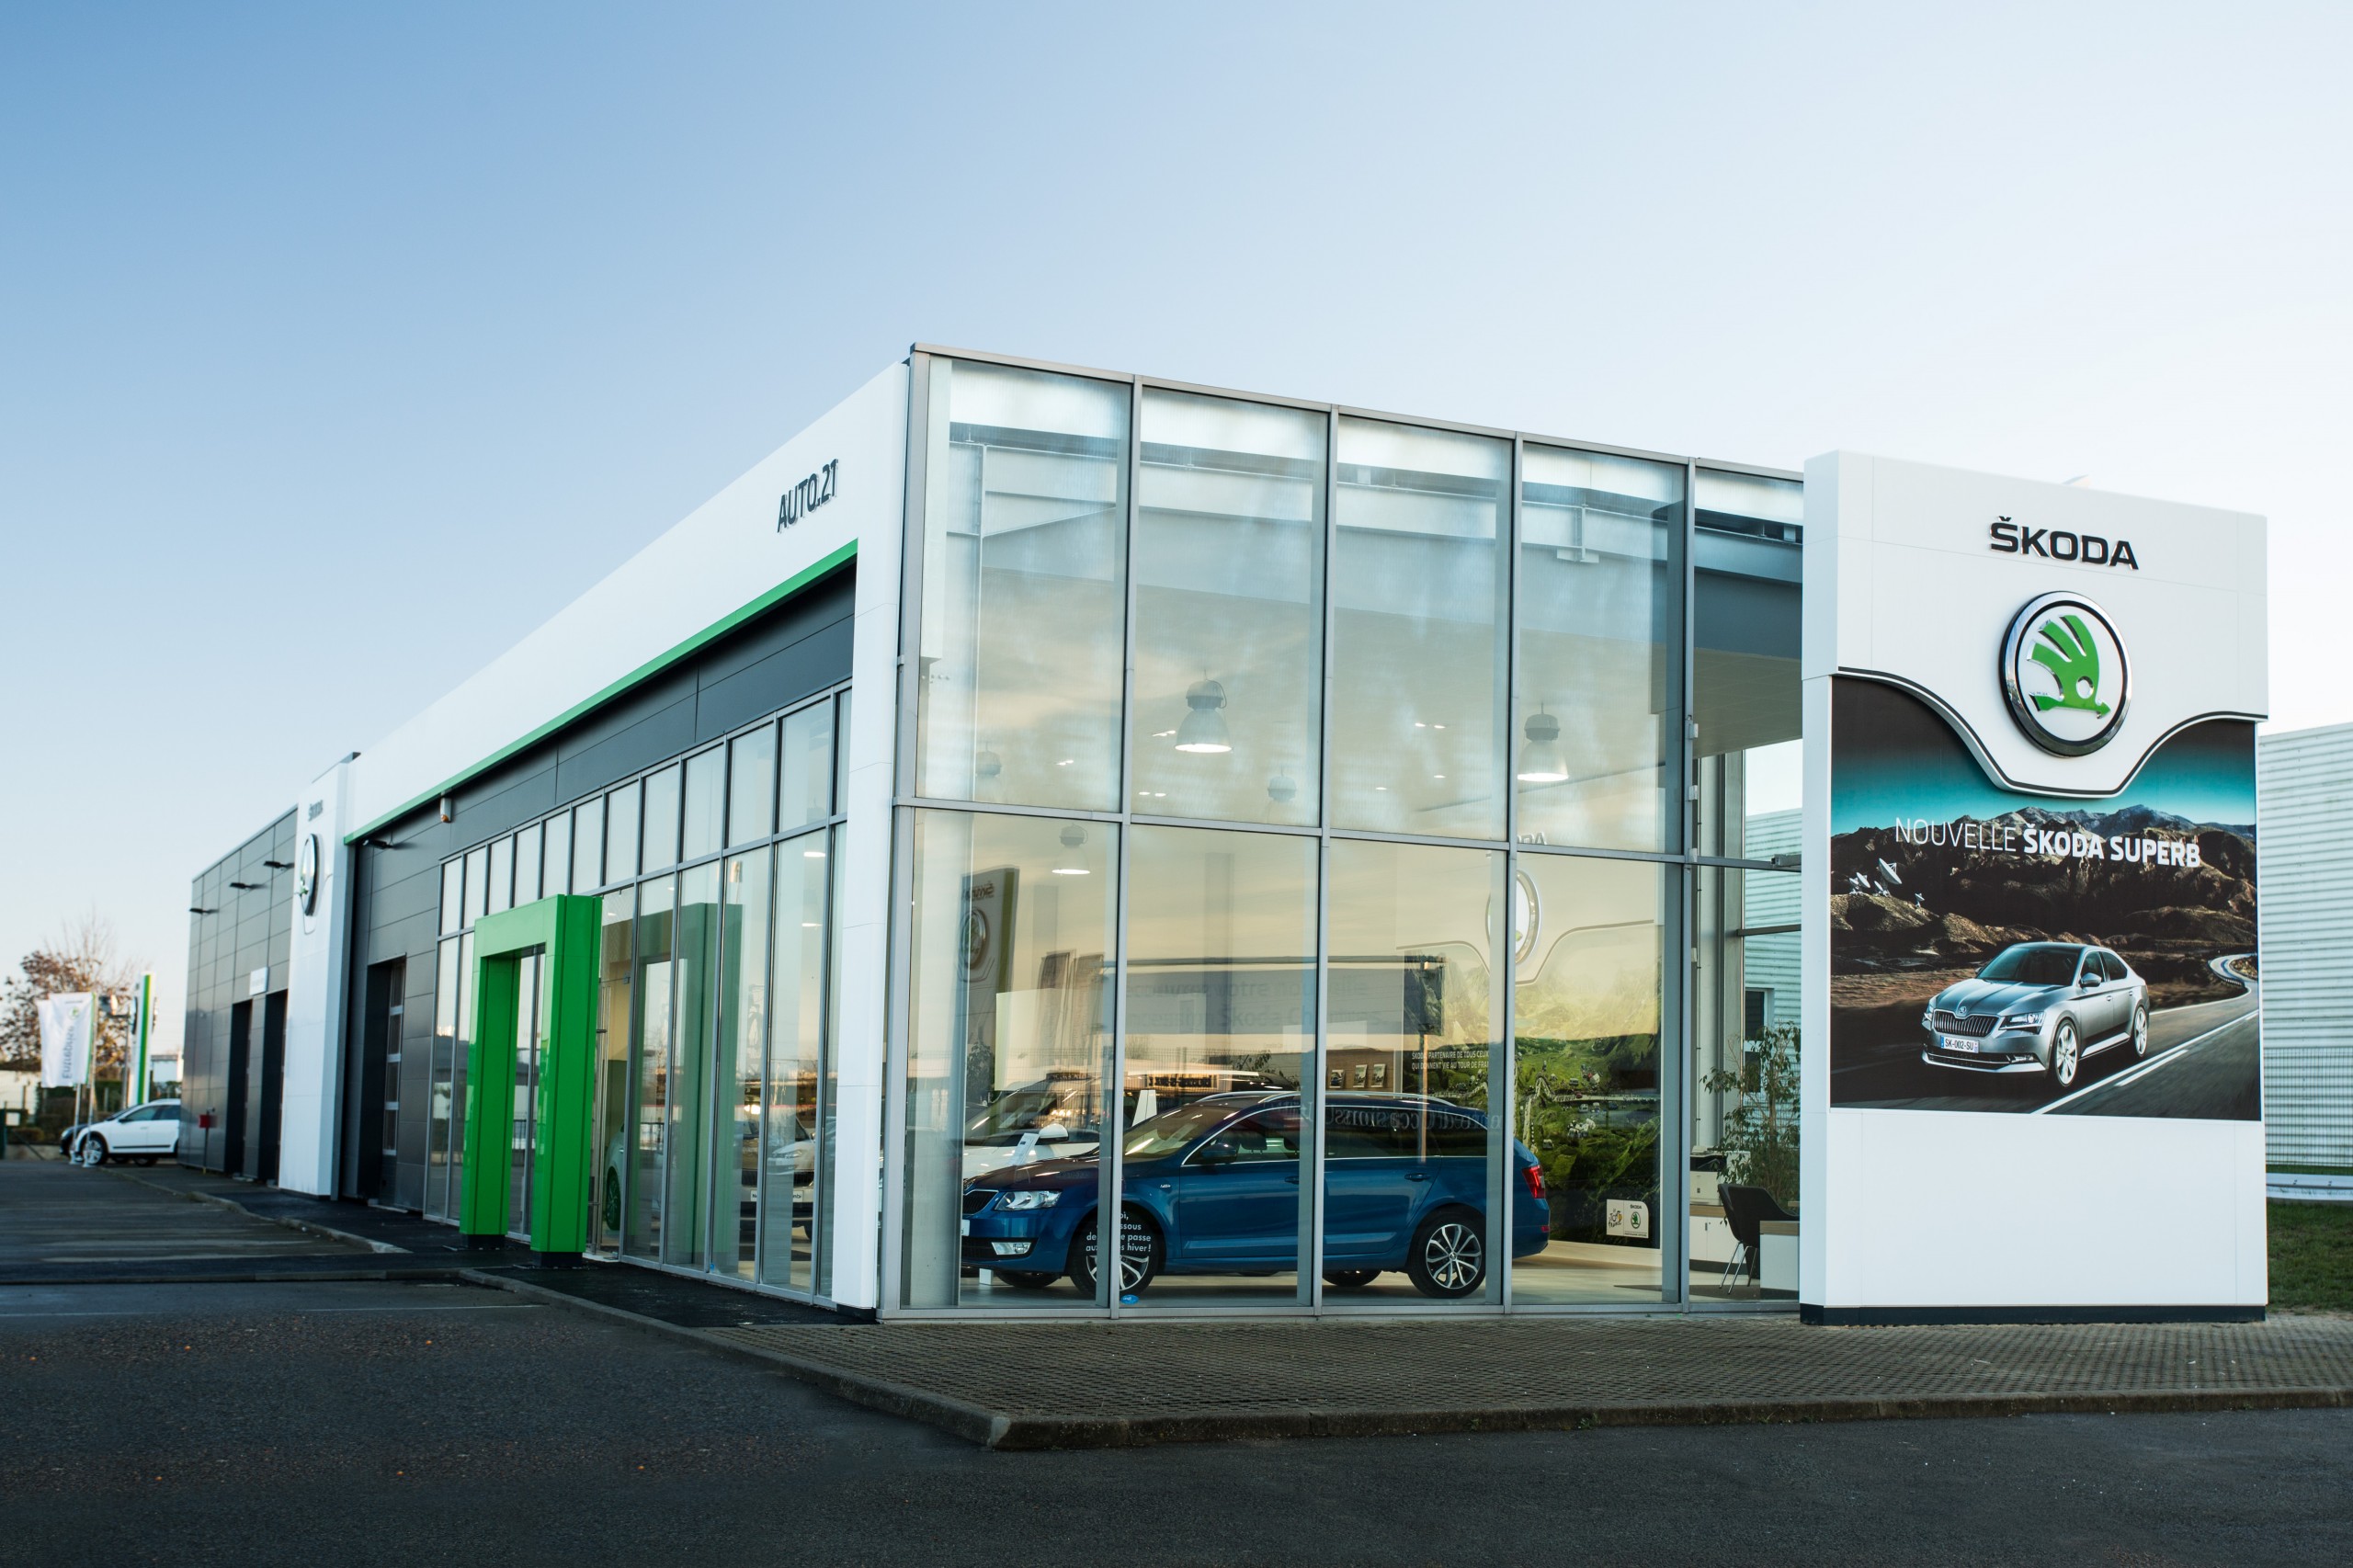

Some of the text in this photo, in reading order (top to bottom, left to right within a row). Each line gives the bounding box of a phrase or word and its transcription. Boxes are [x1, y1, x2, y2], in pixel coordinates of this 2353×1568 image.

[777, 458, 838, 533] AUTO.21
[1990, 516, 2139, 570] ŠKODA
[1895, 817, 2201, 868] NOUVELLE ŠKODA SUPERB
[1945, 1039, 1974, 1051] SK-002-SU
[1412, 1051, 1427, 1060] ŠKOD
[1428, 1051, 1457, 1060] PARTENAIRE
[1457, 1051, 1463, 1059] DE
[1463, 1051, 1476, 1059] TOUS
[1412, 1062, 1420, 1071] QUI
[1420, 1062, 1442, 1070] DNNENT
[1471, 1061, 1477, 1069] DE
[1120, 1211, 1129, 1220] oi,
